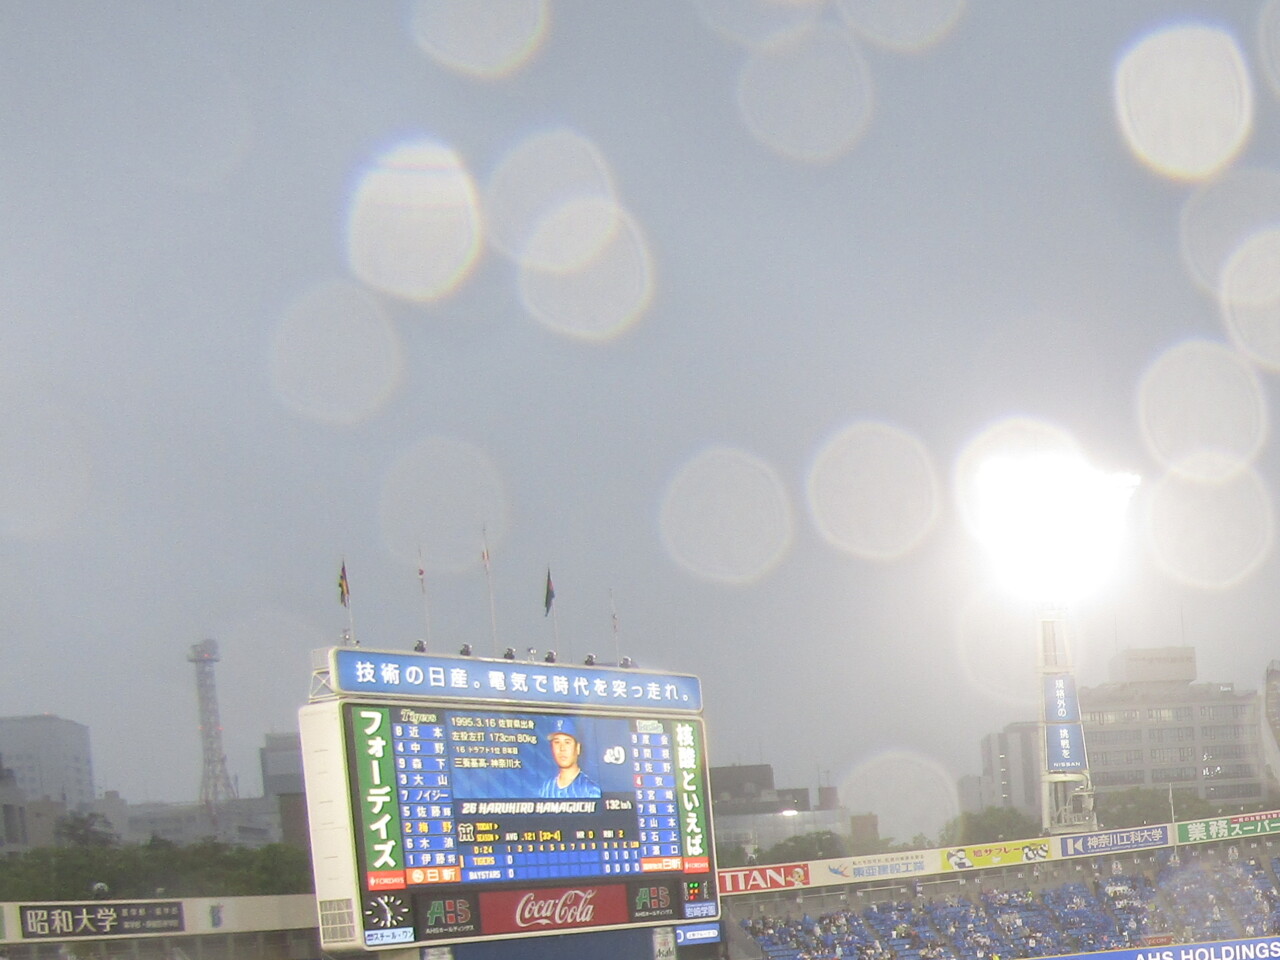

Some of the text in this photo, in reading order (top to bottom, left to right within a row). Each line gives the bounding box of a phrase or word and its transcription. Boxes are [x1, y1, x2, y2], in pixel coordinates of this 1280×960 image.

[1054, 679, 1067, 718] 規格外の
[451, 717, 497, 729] 1995.3.16
[410, 741, 445, 754] 中野
[1059, 728, 1071, 759] 挑戦を
[1053, 761, 1081, 769] NISSAN
[400, 774, 448, 786] 3 大山
[401, 790, 449, 801] 7 ノイジー
[403, 806, 411, 817] 5
[462, 801, 597, 815] 26 HARUHIRO HAMAGUCHI
[404, 822, 413, 833] 2
[650, 817, 676, 828] 山本
[505, 832, 519, 841] AVG
[576, 830, 586, 839] HR
[651, 831, 678, 842] 石上
[1087, 825, 1164, 848] 神奈川工科大学
[406, 838, 414, 849] 6
[472, 856, 496, 865] TIGERS
[469, 870, 502, 880] BAYSTARS
[516, 889, 597, 928] Coca-Cola
[26, 908, 119, 935] 昭和大学
